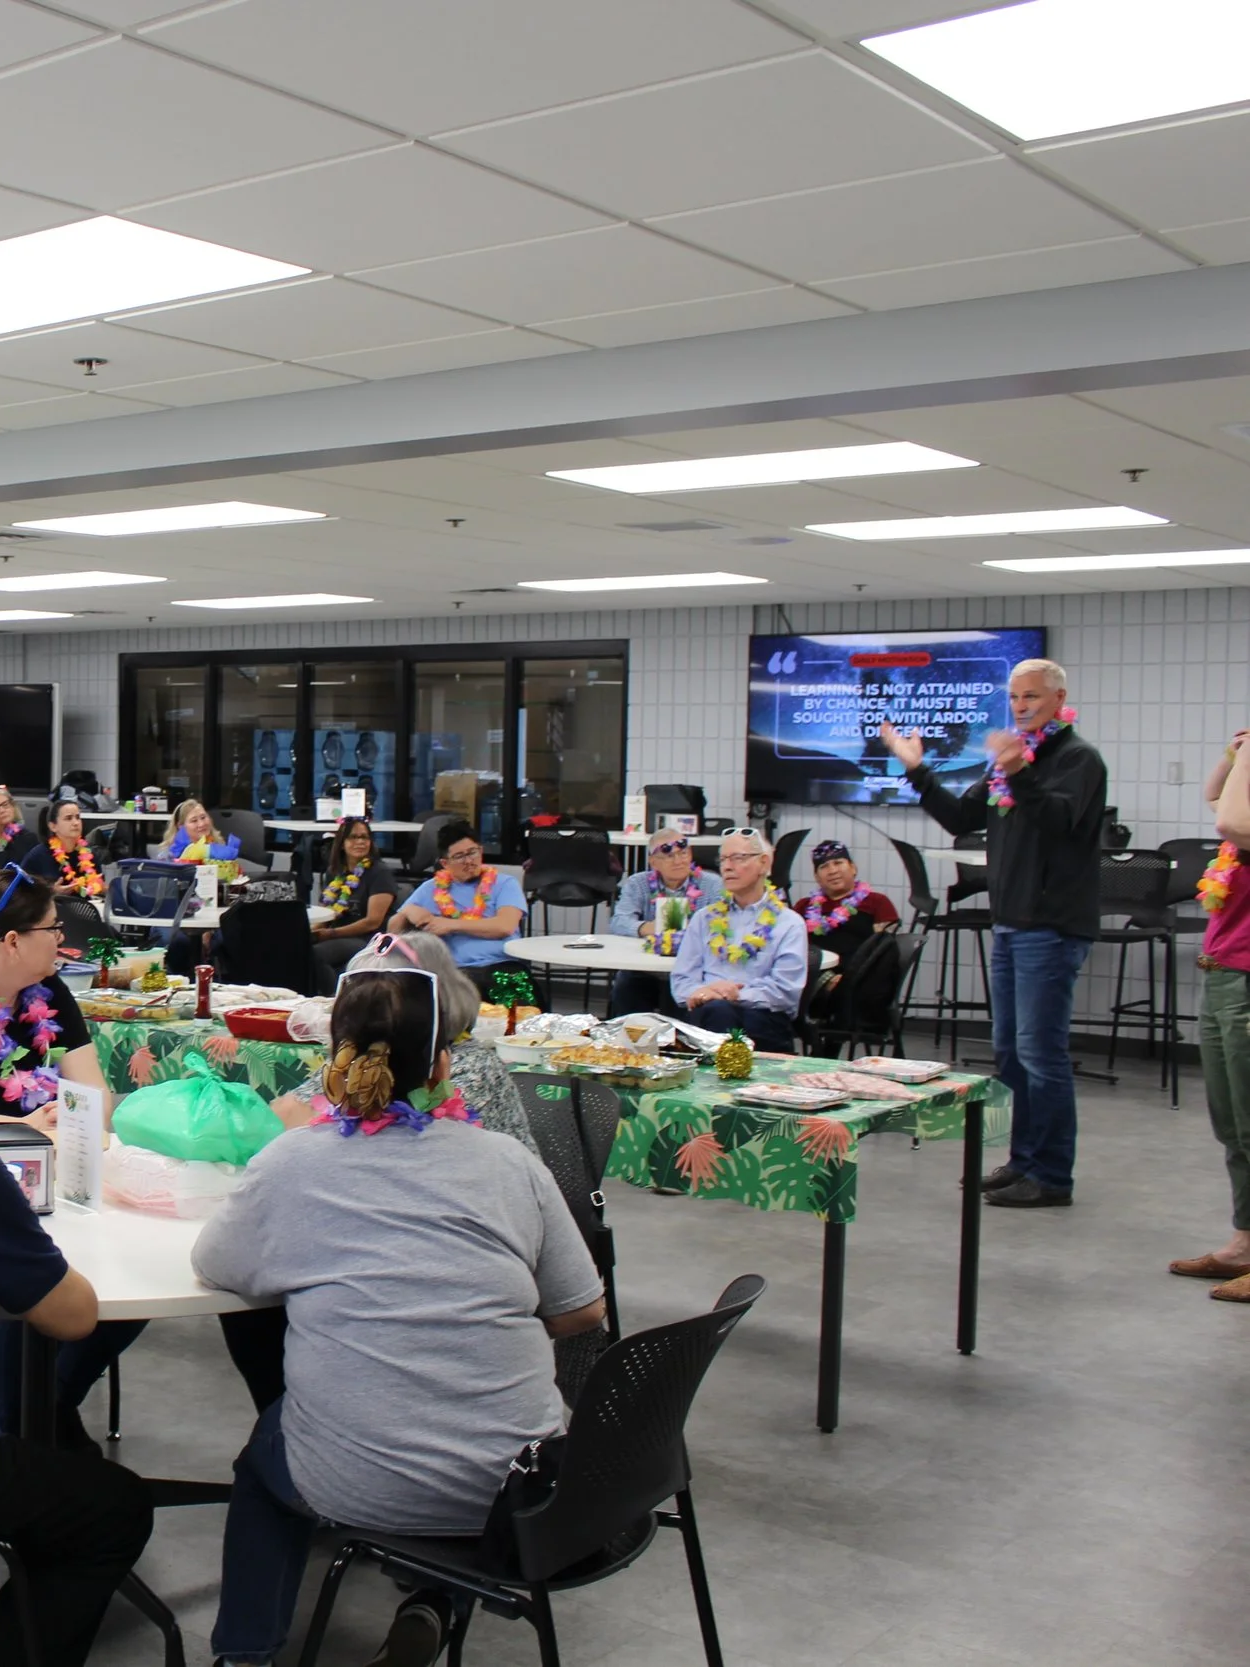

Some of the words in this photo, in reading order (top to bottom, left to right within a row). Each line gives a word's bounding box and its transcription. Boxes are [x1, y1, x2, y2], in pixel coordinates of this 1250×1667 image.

[790, 684, 862, 697] LEARNING
[865, 684, 879, 695] IS
[882, 683, 914, 695] NOT
[916, 682, 994, 695] ATTAINED
[804, 698, 823, 710] BY
[893, 697, 907, 709] IT
[910, 697, 954, 709] MUST
[956, 697, 978, 709] BE
[792, 711, 852, 724] SOUGHT
[857, 711, 886, 724] FOR
[889, 711, 929, 723] WITH
[931, 711, 989, 724] ARDOR
[829, 725, 862, 738] AND
[864, 725, 948, 738] DIGECE.
